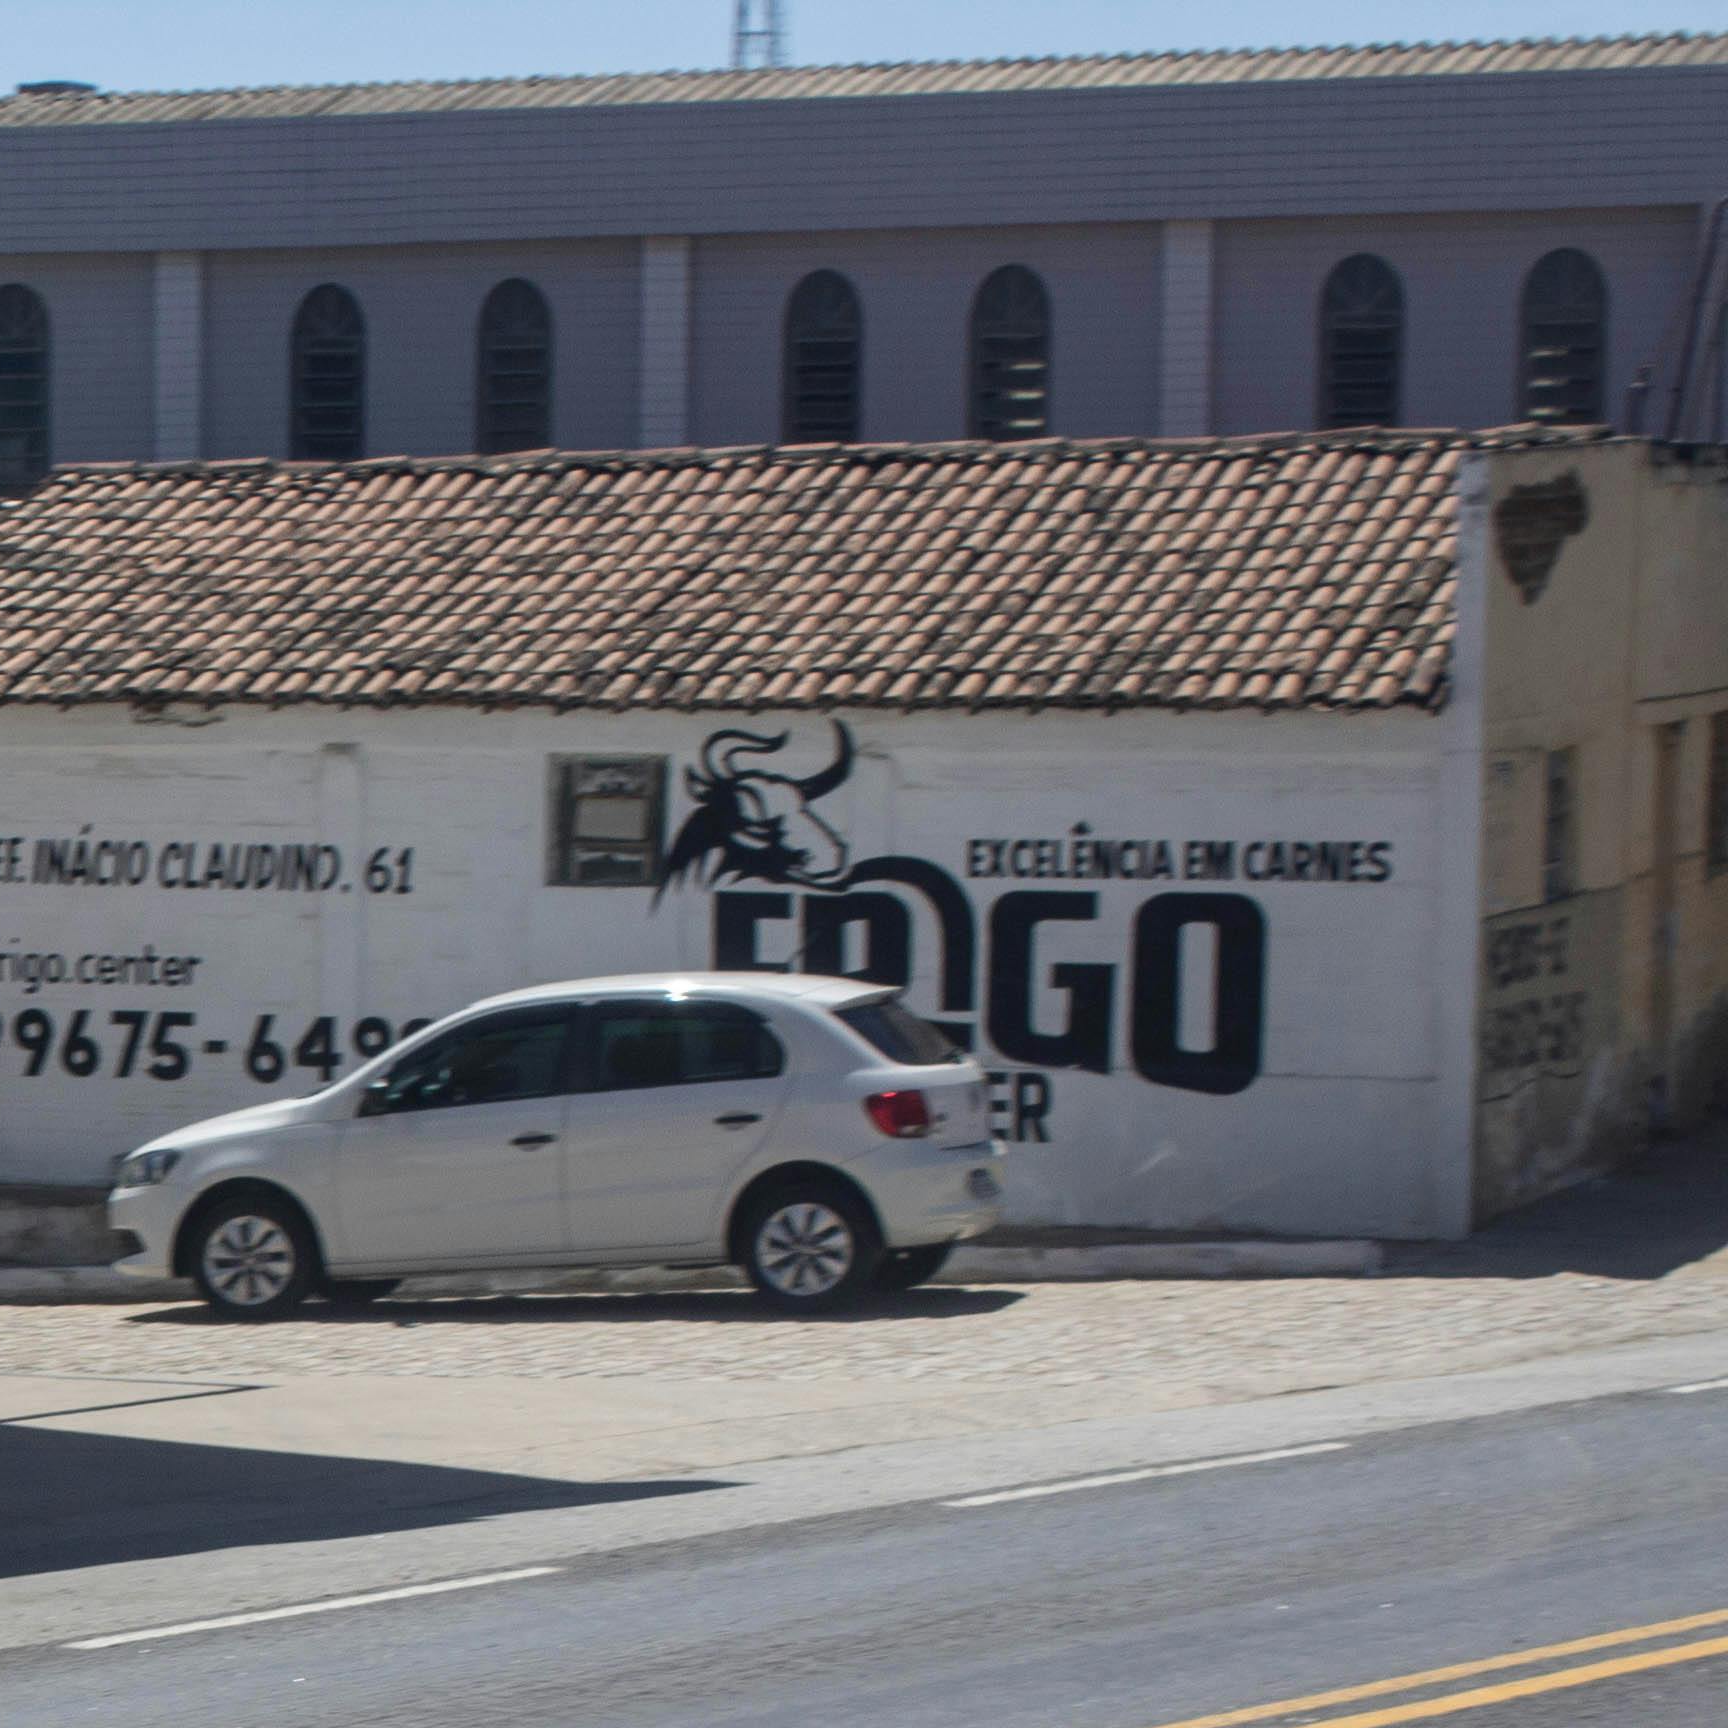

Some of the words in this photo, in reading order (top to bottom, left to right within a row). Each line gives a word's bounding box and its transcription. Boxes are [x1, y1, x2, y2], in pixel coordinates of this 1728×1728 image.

[30, 823, 150, 887] INÁCIO
[363, 846, 416, 895] 61
[965, 821, 1176, 881] EXCELÊNCIA
[1181, 839, 1238, 882] EM
[1243, 840, 1395, 884] CARNES
